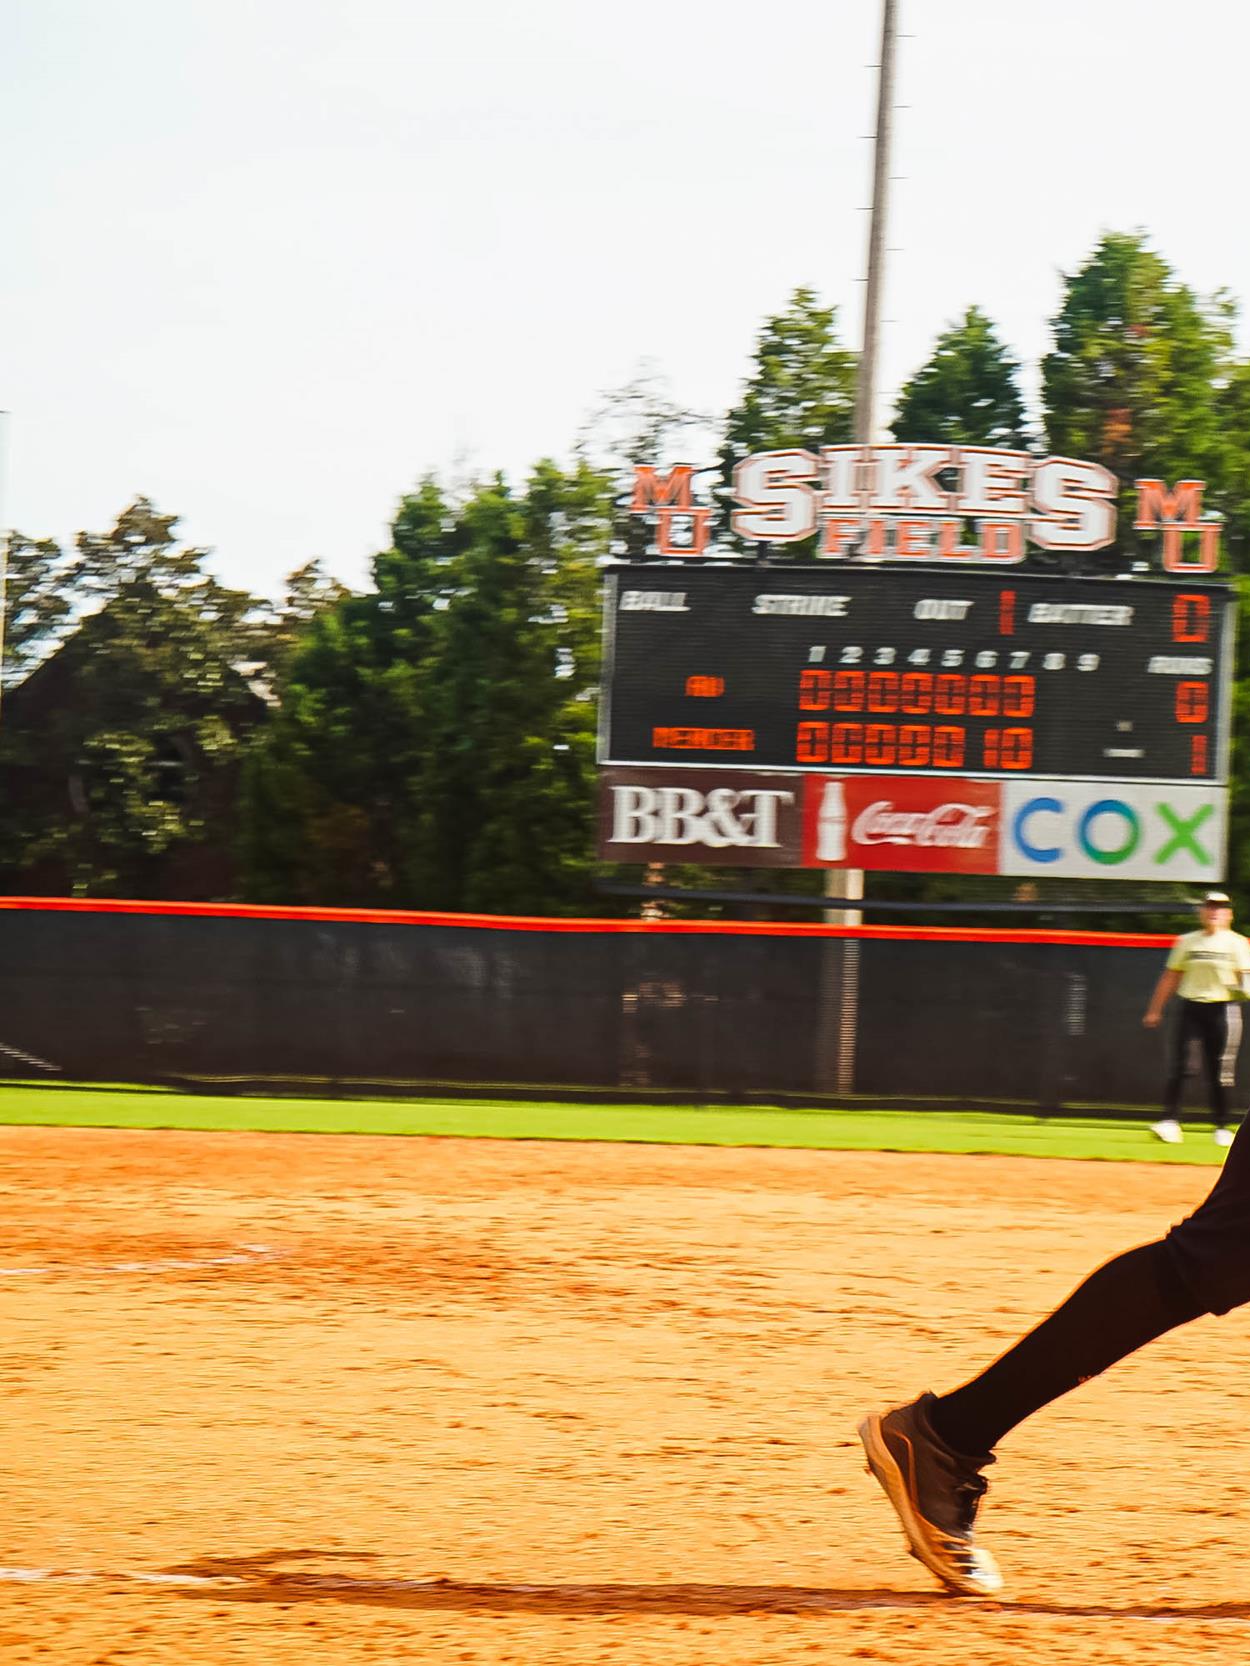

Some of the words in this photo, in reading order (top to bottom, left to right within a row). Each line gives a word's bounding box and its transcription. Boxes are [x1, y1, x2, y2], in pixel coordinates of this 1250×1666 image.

[730, 442, 1119, 551] SIKES
[817, 513, 1027, 564] FIELD
[608, 786, 794, 848] BB&T
[1013, 797, 1214, 866] COX
